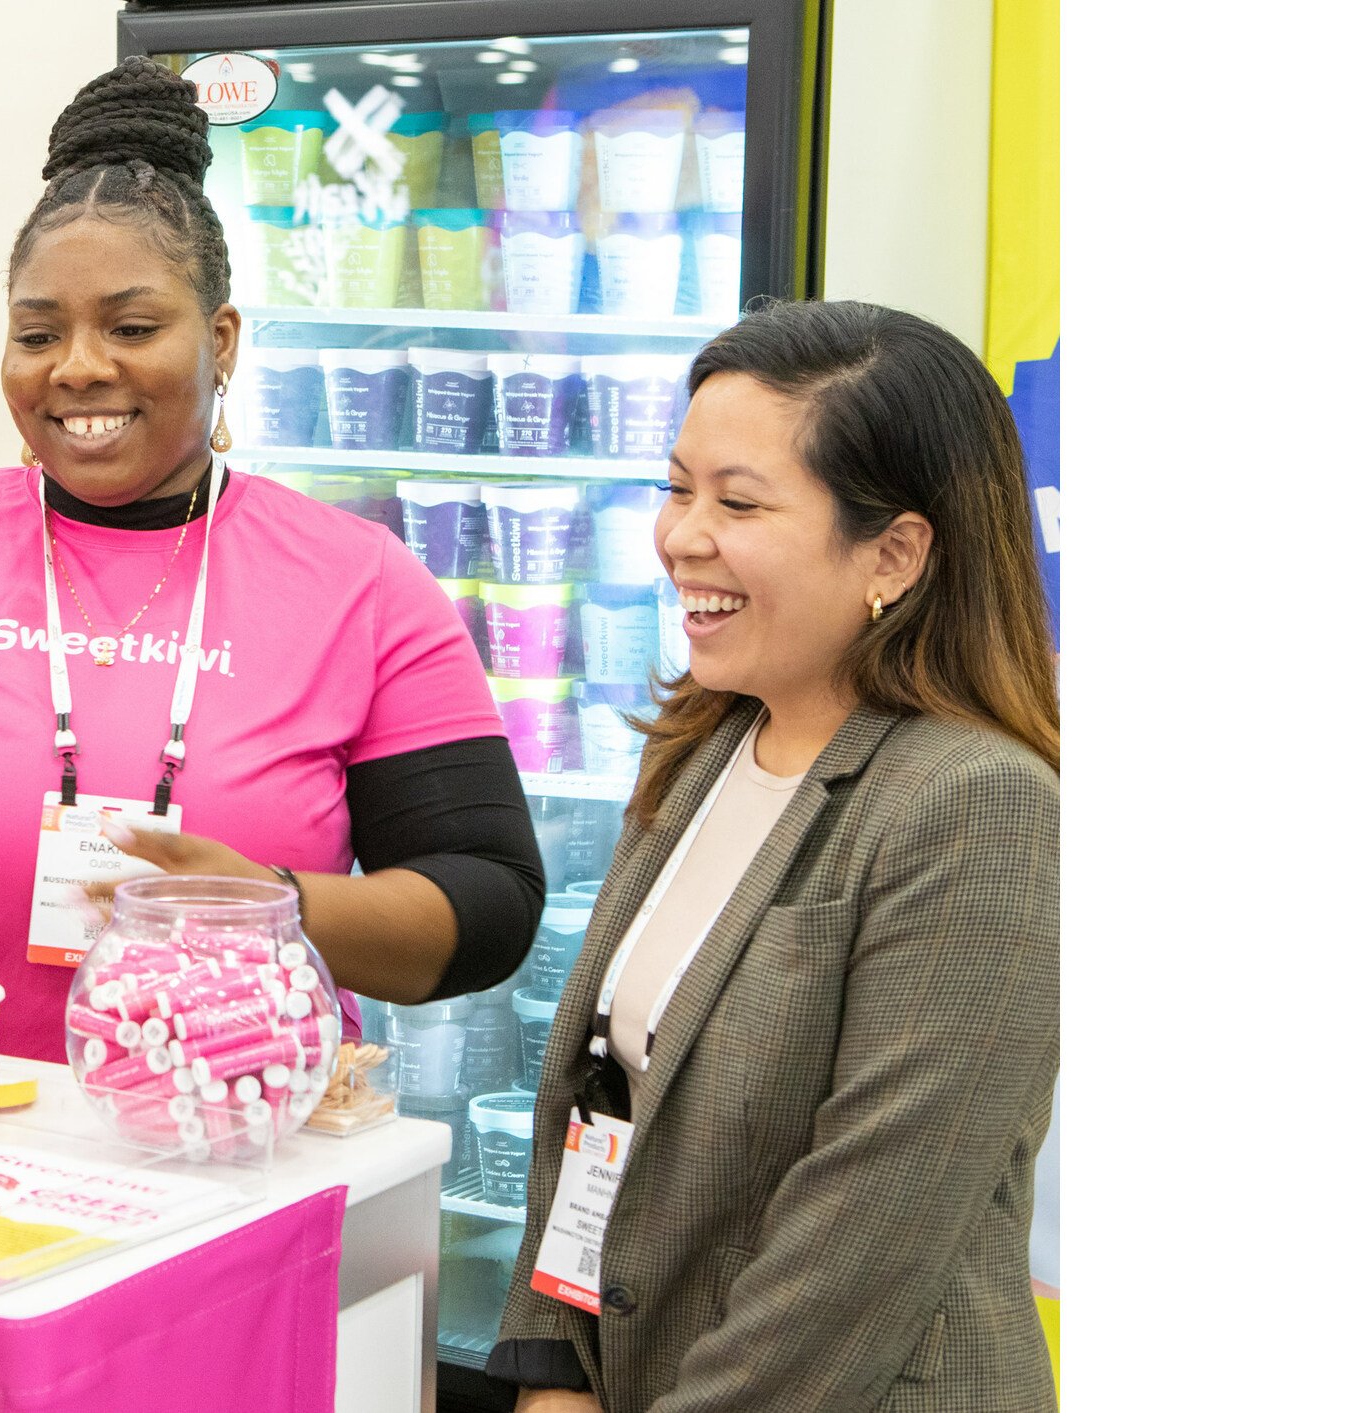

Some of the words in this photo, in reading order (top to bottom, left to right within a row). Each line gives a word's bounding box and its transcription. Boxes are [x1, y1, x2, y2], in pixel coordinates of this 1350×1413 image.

[195, 81, 258, 104] LOWE
[416, 379, 424, 443] Sweetkiwi
[453, 414, 471, 424] Ginger
[608, 386, 619, 454] Sweetkiwi
[509, 518, 521, 582] Sweetkiwi
[598, 616, 609, 676] Sweetkiwi
[89, 858, 122, 871] OJIOR
[43, 875, 88, 887] BUSINESS
[548, 966, 565, 974] Cream
[587, 1164, 622, 1183] JENNIF
[569, 1201, 590, 1216] BRAND
[576, 1219, 604, 1236] SWEET
